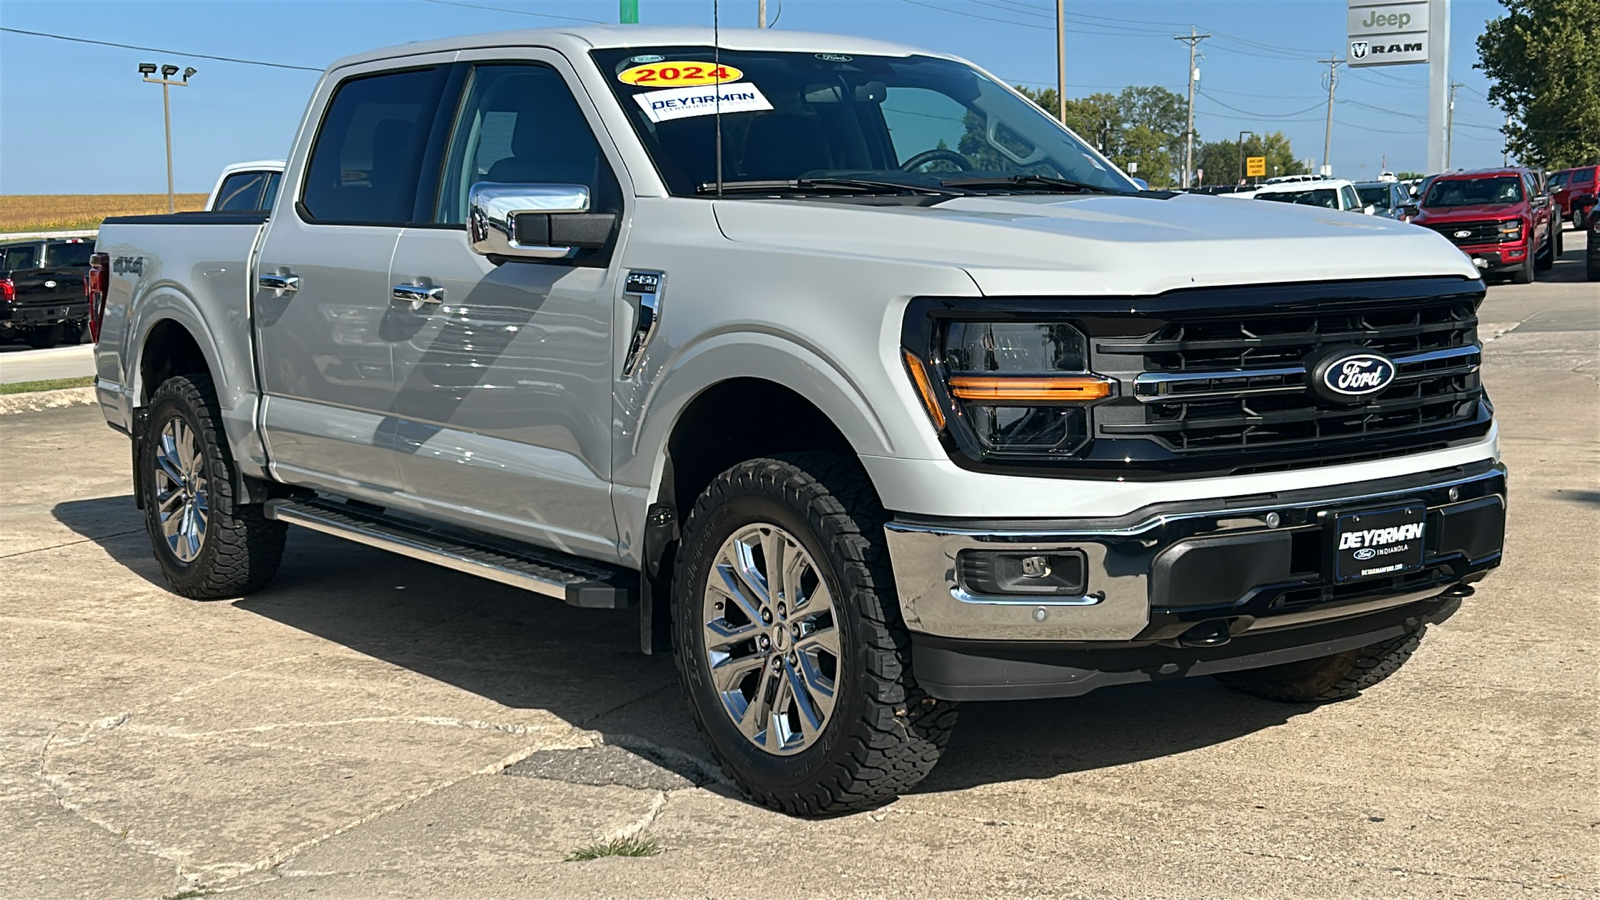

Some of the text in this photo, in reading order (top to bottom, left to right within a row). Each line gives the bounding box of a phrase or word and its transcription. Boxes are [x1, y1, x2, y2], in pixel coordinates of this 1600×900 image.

[1362, 11, 1411, 28] Jeep
[1371, 43, 1422, 54] RAM
[634, 66, 730, 83] 2024
[652, 92, 756, 110] DEYARMAN
[1338, 361, 1383, 389] Ford
[1339, 522, 1425, 550] DEYARMAN
[1376, 544, 1409, 556] INDIANOLA
